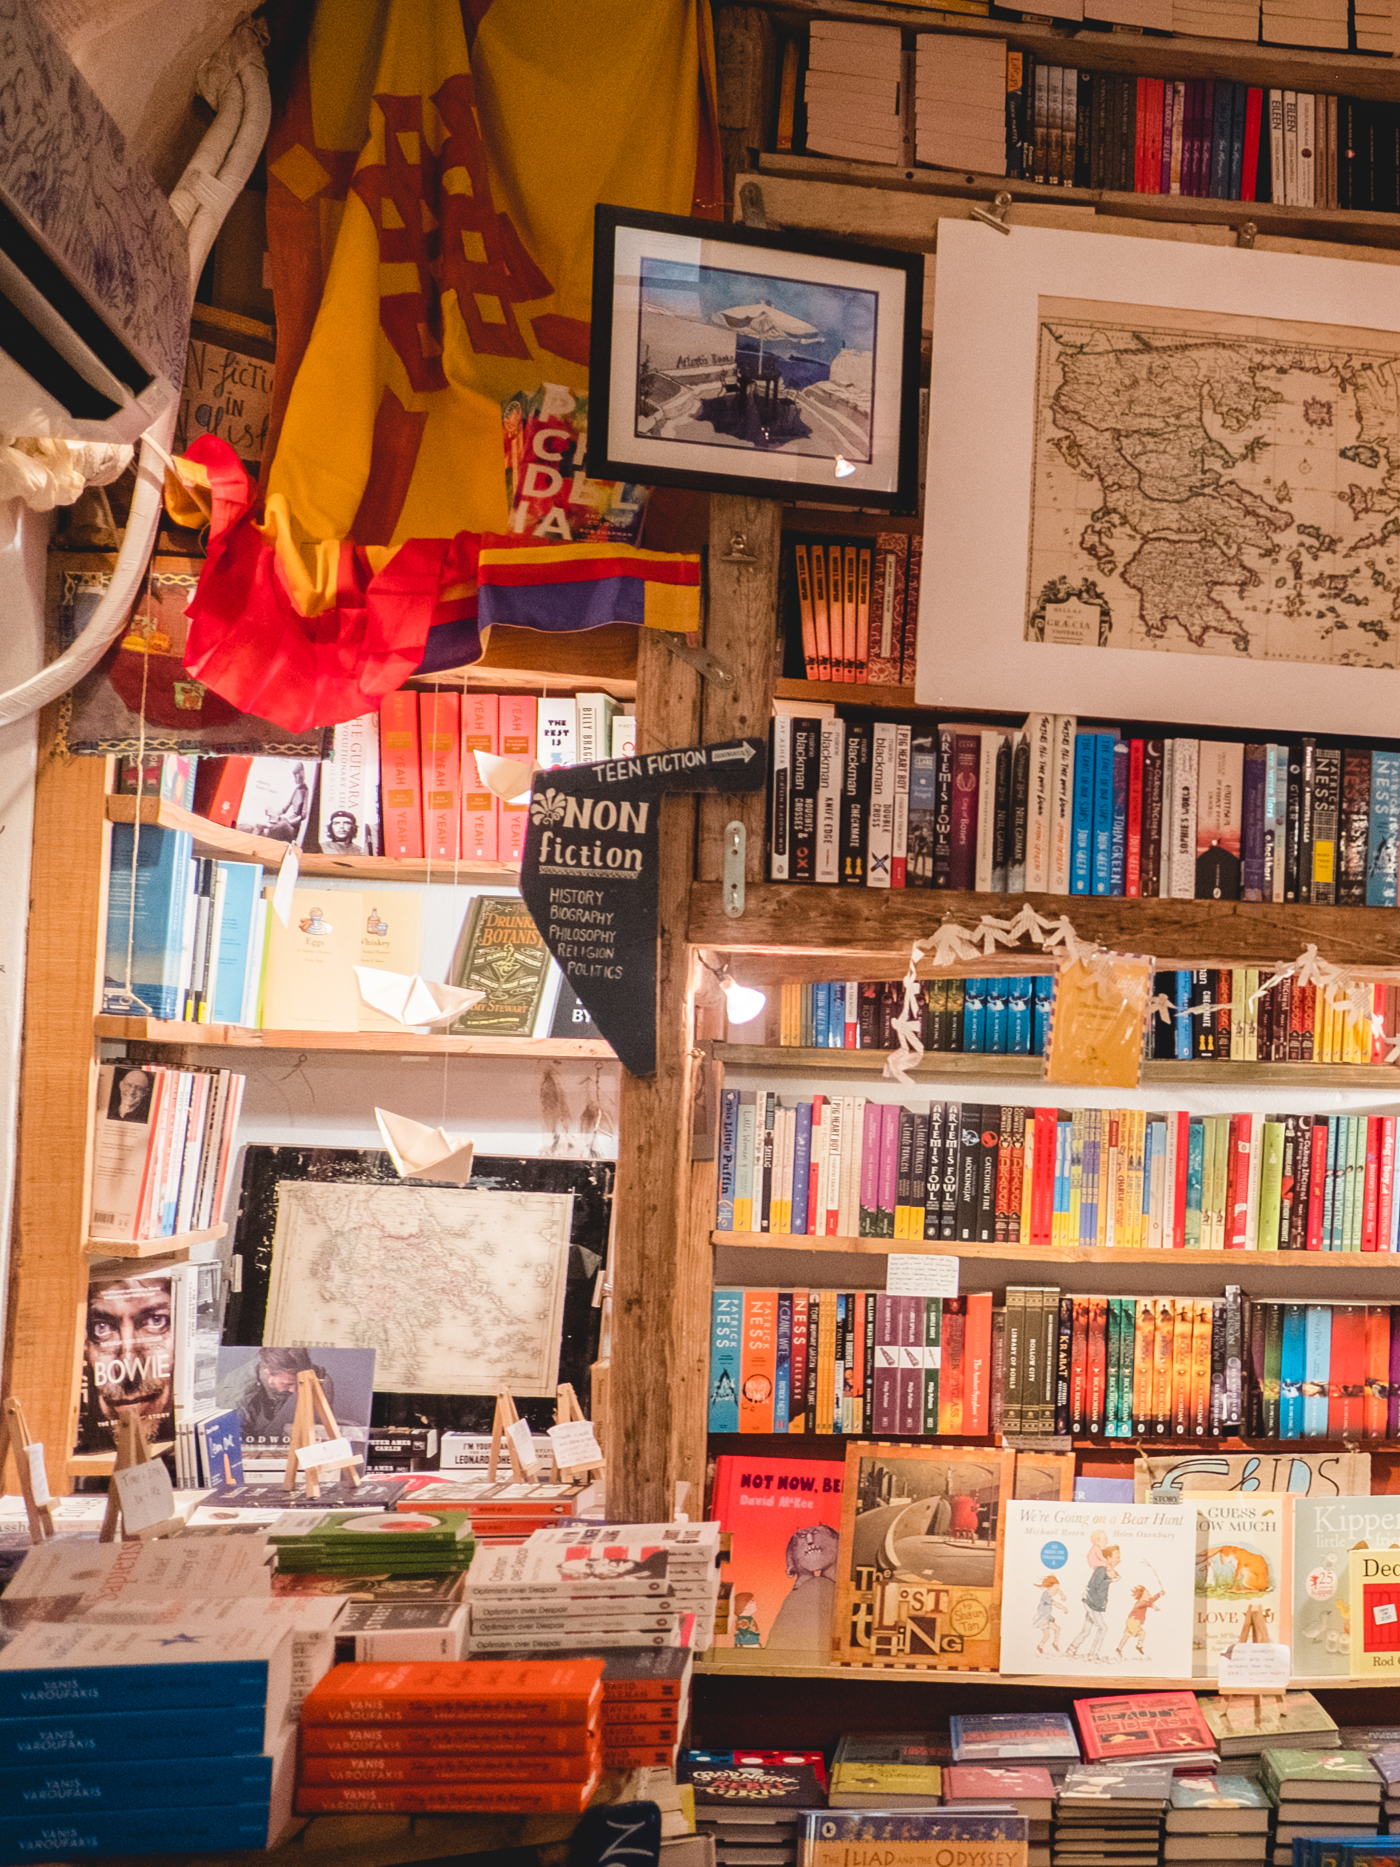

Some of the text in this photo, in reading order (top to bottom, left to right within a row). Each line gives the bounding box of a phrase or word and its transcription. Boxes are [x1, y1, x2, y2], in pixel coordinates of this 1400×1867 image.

[1271, 100, 1283, 130] EILEEN
[1286, 102, 1297, 132] EILEEN
[582, 707, 592, 731] BILLY
[592, 749, 707, 783] TEEN FICTION
[795, 732, 808, 790] blackman
[820, 731, 833, 789] blackman
[847, 738, 860, 796] blackman
[897, 748, 908, 791] HEART BOY
[347, 742, 362, 810] GUEVARA
[1314, 758, 1338, 811] PATRICK NESS
[1375, 760, 1390, 814] NESS
[936, 732, 952, 845] ARTEMIS FOWL
[1266, 768, 1275, 818] were liars
[1181, 786, 1190, 814] WORLD
[564, 796, 649, 834] NON
[823, 797, 834, 845] KNIFE EDGE
[850, 803, 861, 848] CHECKMATE
[872, 803, 881, 828] CROSS
[882, 803, 892, 834] DOUBLE
[539, 831, 643, 871] fiction
[550, 888, 604, 906] HISTORY
[549, 905, 615, 926] BIOGRAPHY
[549, 924, 617, 944] PHILOSOPHY
[557, 943, 615, 960] RELIGION
[567, 961, 624, 980] POLITICS
[830, 1117, 841, 1137] HEART
[926, 1104, 942, 1201] ARTEMIS FOWL
[1383, 1135, 1394, 1154] dog
[721, 1153, 733, 1194] Puffin
[964, 1156, 973, 1203] MOCKINGJAY
[982, 1156, 993, 1211] CATCHING FIRE
[94, 1354, 171, 1387] BOWIE
[455, 1455, 489, 1465] LEONARD
[740, 1473, 818, 1494] NOT NOW,
[740, 1494, 774, 1507] David
[1153, 1495, 1179, 1503] STORY
[1020, 1509, 1184, 1527] We're Going on Bear Hunt
[1207, 1507, 1256, 1519] GUESS
[1024, 1527, 1086, 1537] Michael Rosen
[1112, 1529, 1134, 1538] Helen
[1228, 1521, 1276, 1532] MUCH
[1316, 1534, 1346, 1548] little
[472, 1587, 510, 1596] Optimism
[530, 1585, 558, 1595] Despair
[482, 1606, 568, 1616] Optimism over Despair
[954, 1608, 984, 1620] Shaun
[1198, 1612, 1239, 1624] LOVE
[479, 1623, 516, 1632] Optimism
[961, 1622, 980, 1630] Tan
[1372, 1655, 1394, 1667] Rod
[822, 1848, 1018, 1867] THE ILIAD AND THE ODYSSEY
